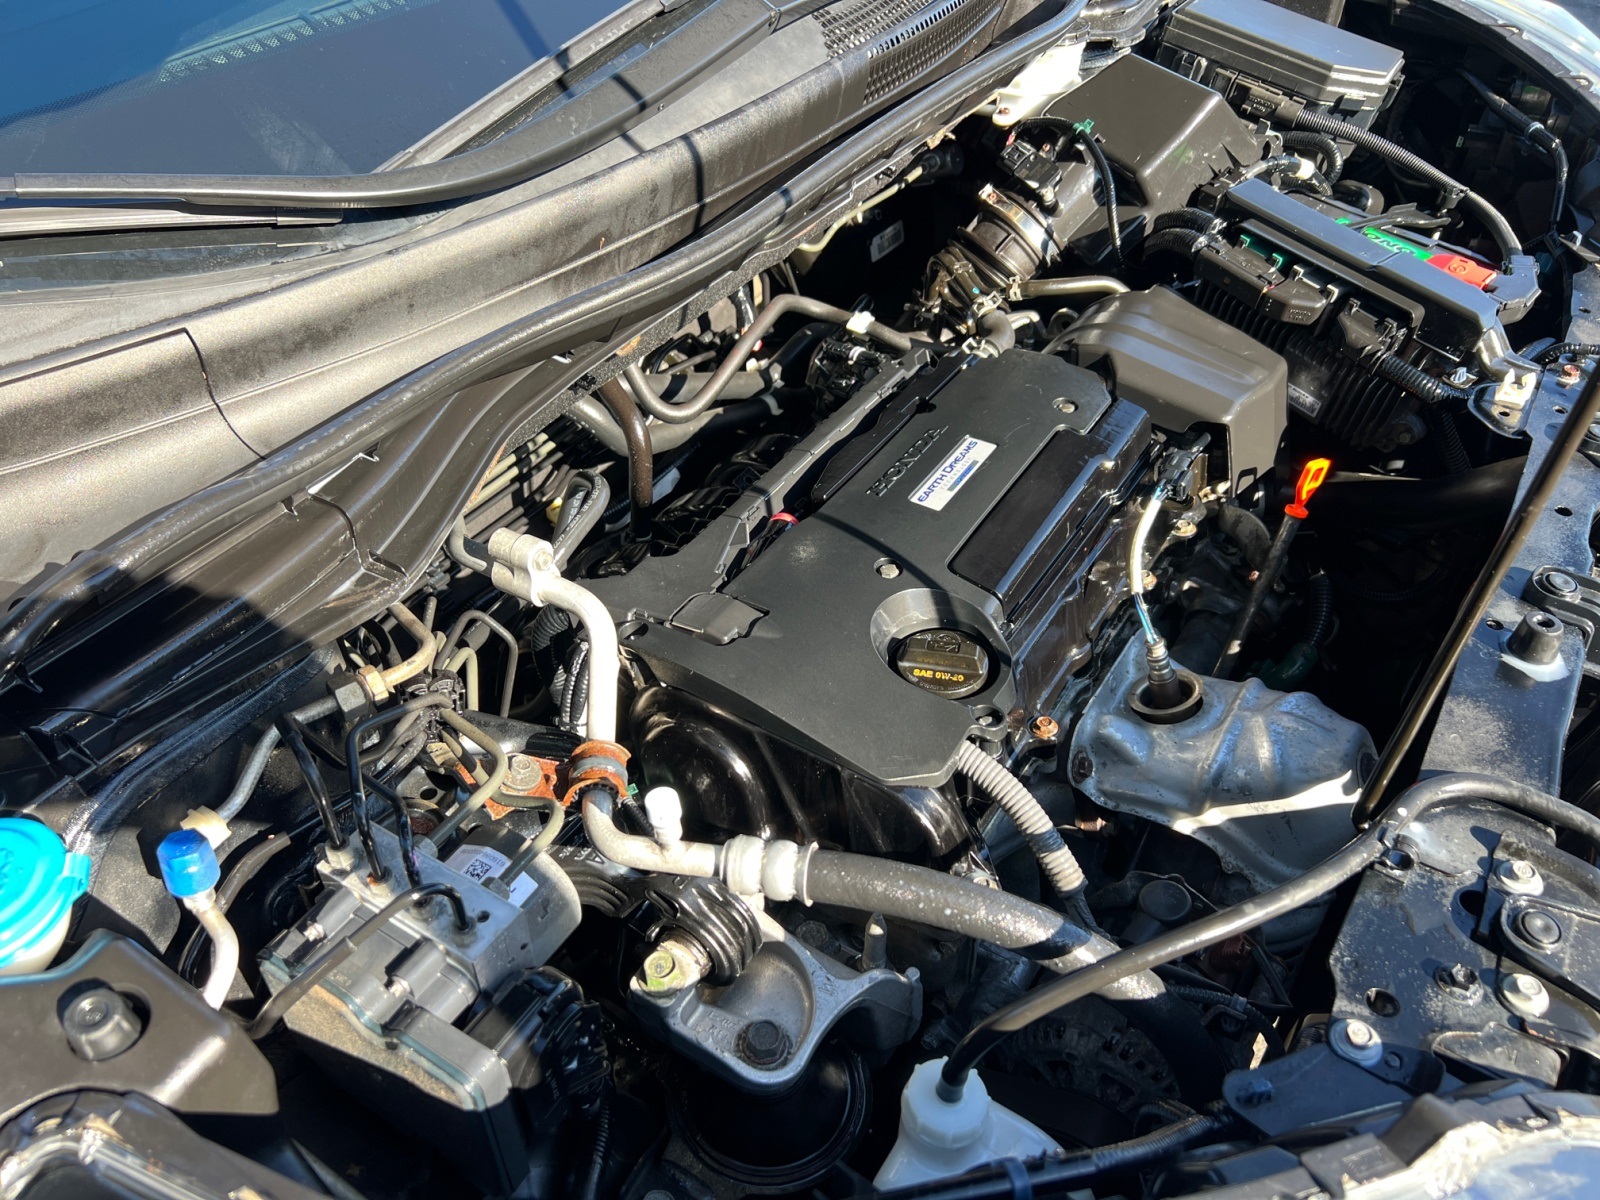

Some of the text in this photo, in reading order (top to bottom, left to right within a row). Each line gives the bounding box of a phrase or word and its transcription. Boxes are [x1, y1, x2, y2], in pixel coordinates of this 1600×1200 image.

[865, 425, 949, 497] HONDA
[917, 472, 947, 503] EARTH
[942, 440, 978, 476] DREAMS
[913, 668, 934, 678] SAE
[935, 672, 965, 682] 0W-20
